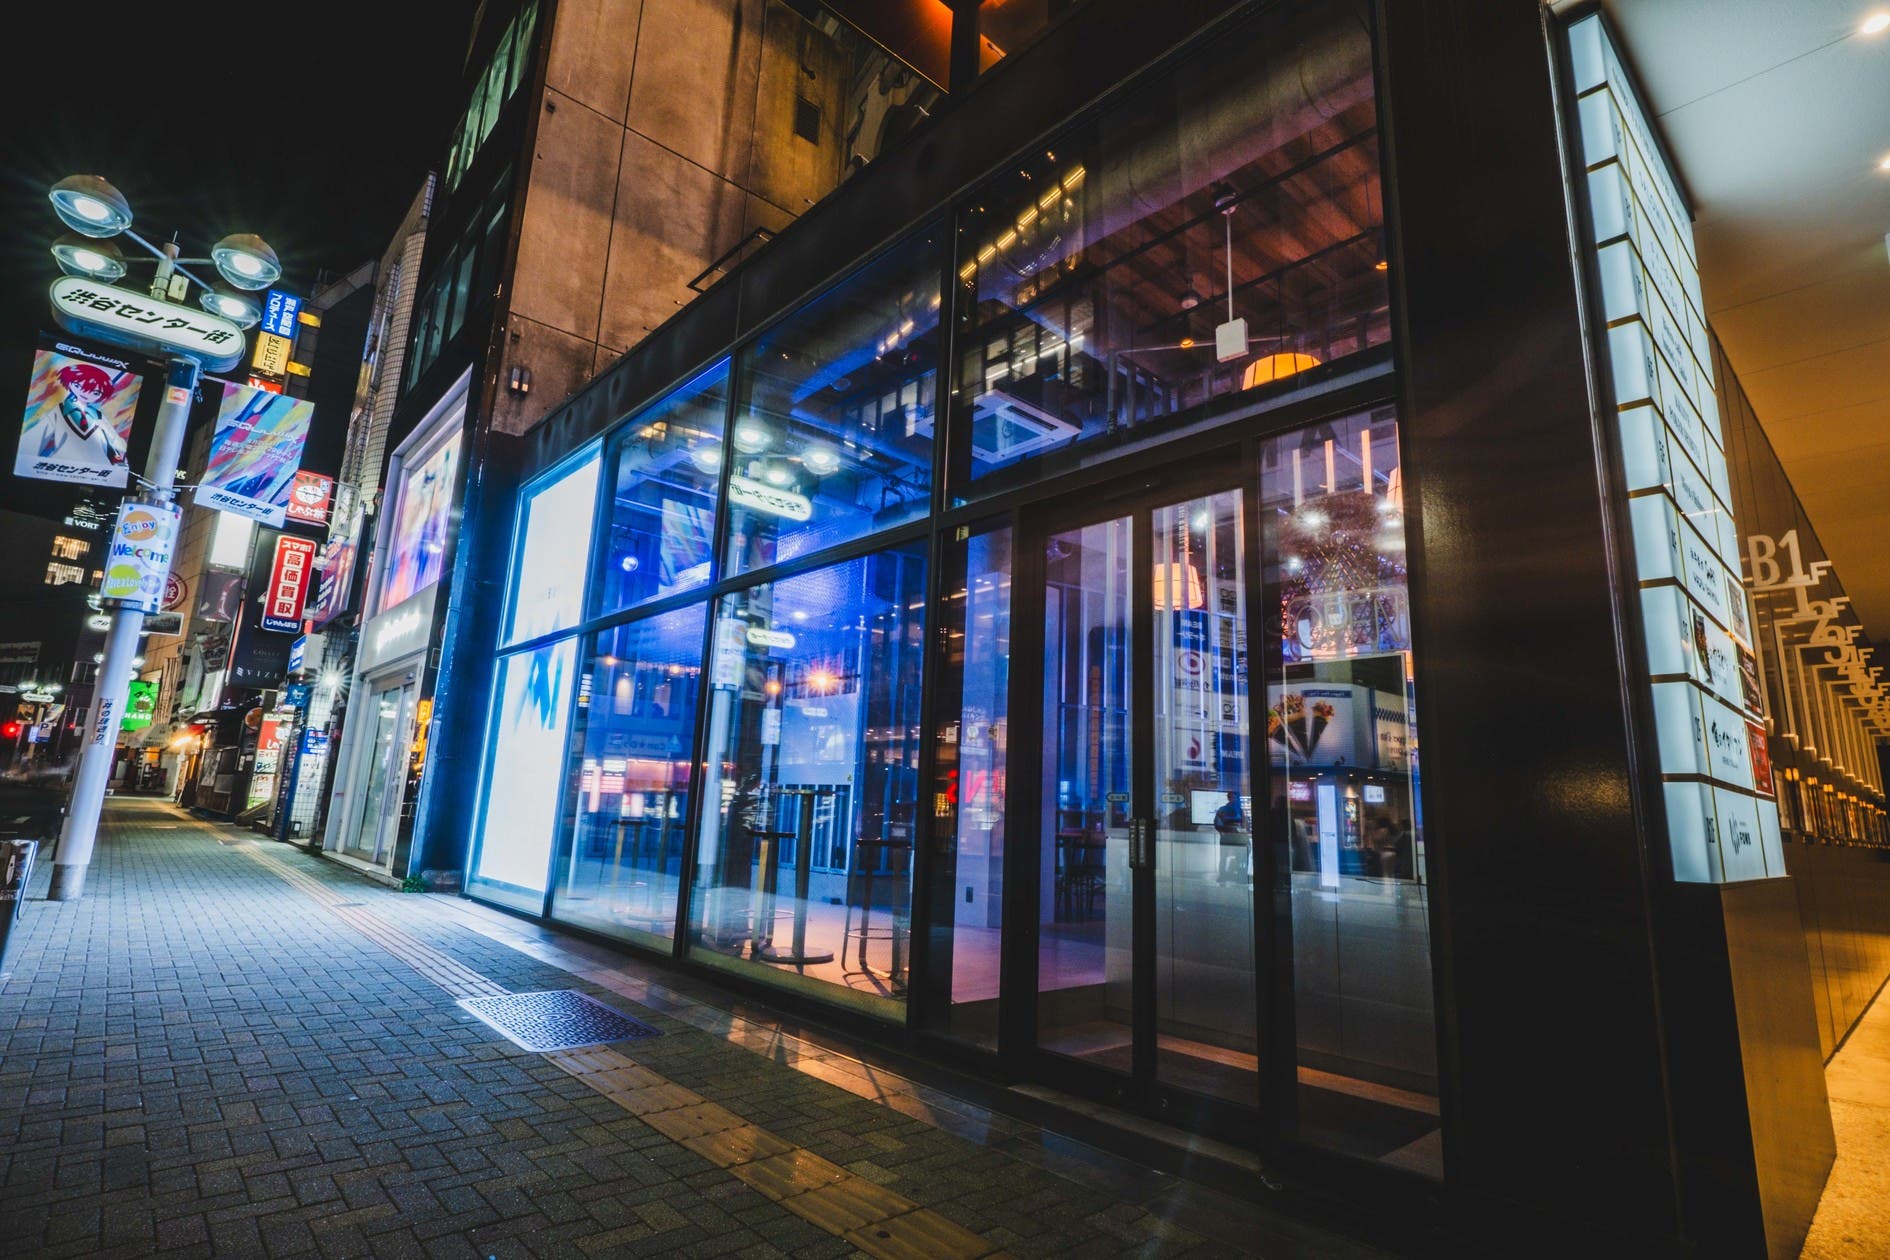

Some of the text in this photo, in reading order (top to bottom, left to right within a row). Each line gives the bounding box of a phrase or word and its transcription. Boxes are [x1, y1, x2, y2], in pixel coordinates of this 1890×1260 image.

[62, 289, 235, 345] 渋谷センター街
[33, 462, 112, 478] 渋谷センター街
[210, 492, 274, 516] 渋谷センター街
[75, 519, 100, 530] VORT
[122, 520, 156, 535] Enjoy
[112, 543, 169, 564] Welcome
[1748, 530, 1832, 587] B1F
[277, 553, 302, 615] 高価買取
[266, 618, 298, 629] じゃんぱら
